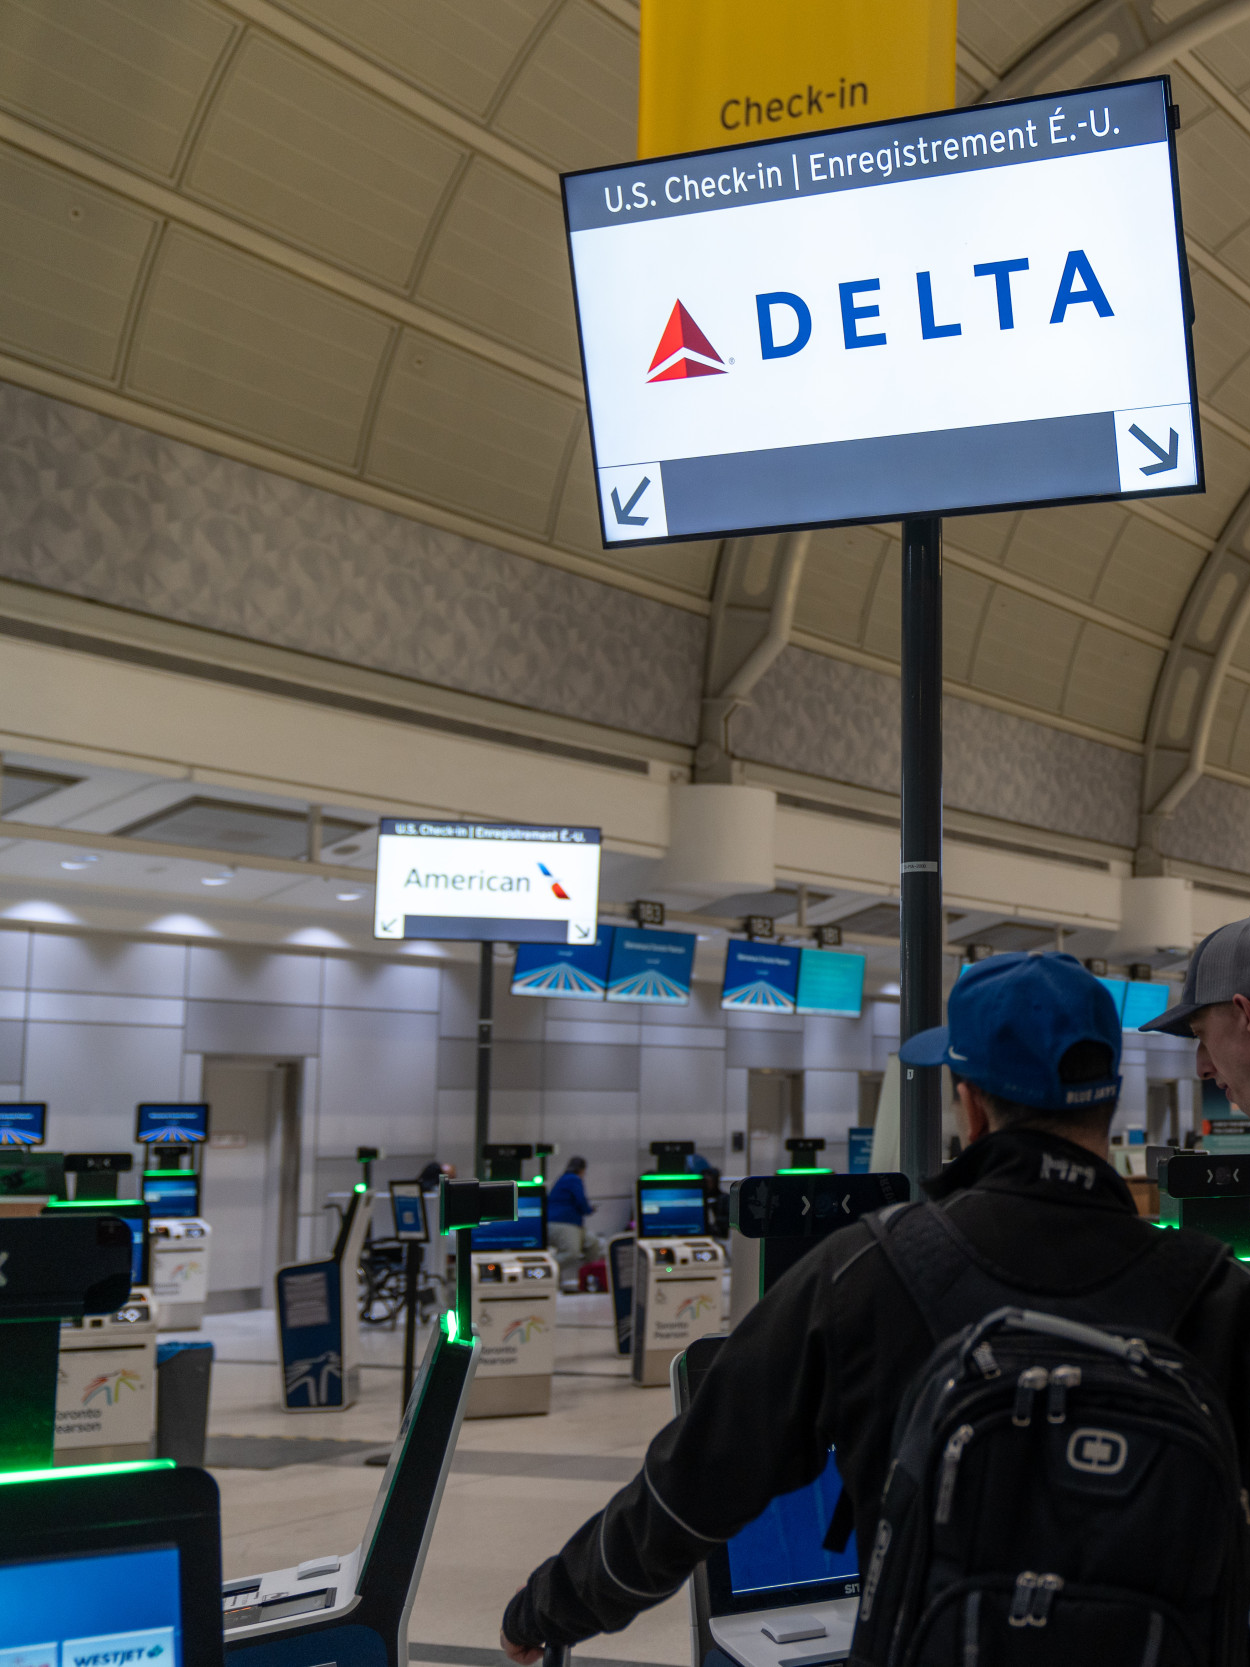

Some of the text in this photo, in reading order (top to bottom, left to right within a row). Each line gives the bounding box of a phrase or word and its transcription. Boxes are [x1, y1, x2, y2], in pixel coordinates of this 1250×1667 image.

[720, 77, 869, 131] Check-in
[604, 107, 1120, 213] U.S. Check-in Enregistrement É.-U.
[755, 249, 1115, 360] DELTA
[395, 823, 417, 835] U.S.
[419, 823, 468, 838] Check-in
[475, 826, 558, 842] Enregistrement
[404, 868, 531, 893] American
[55, 1410, 102, 1421] oronto
[54, 1423, 103, 1434] earson
[74, 1647, 145, 1667] WESTJET
